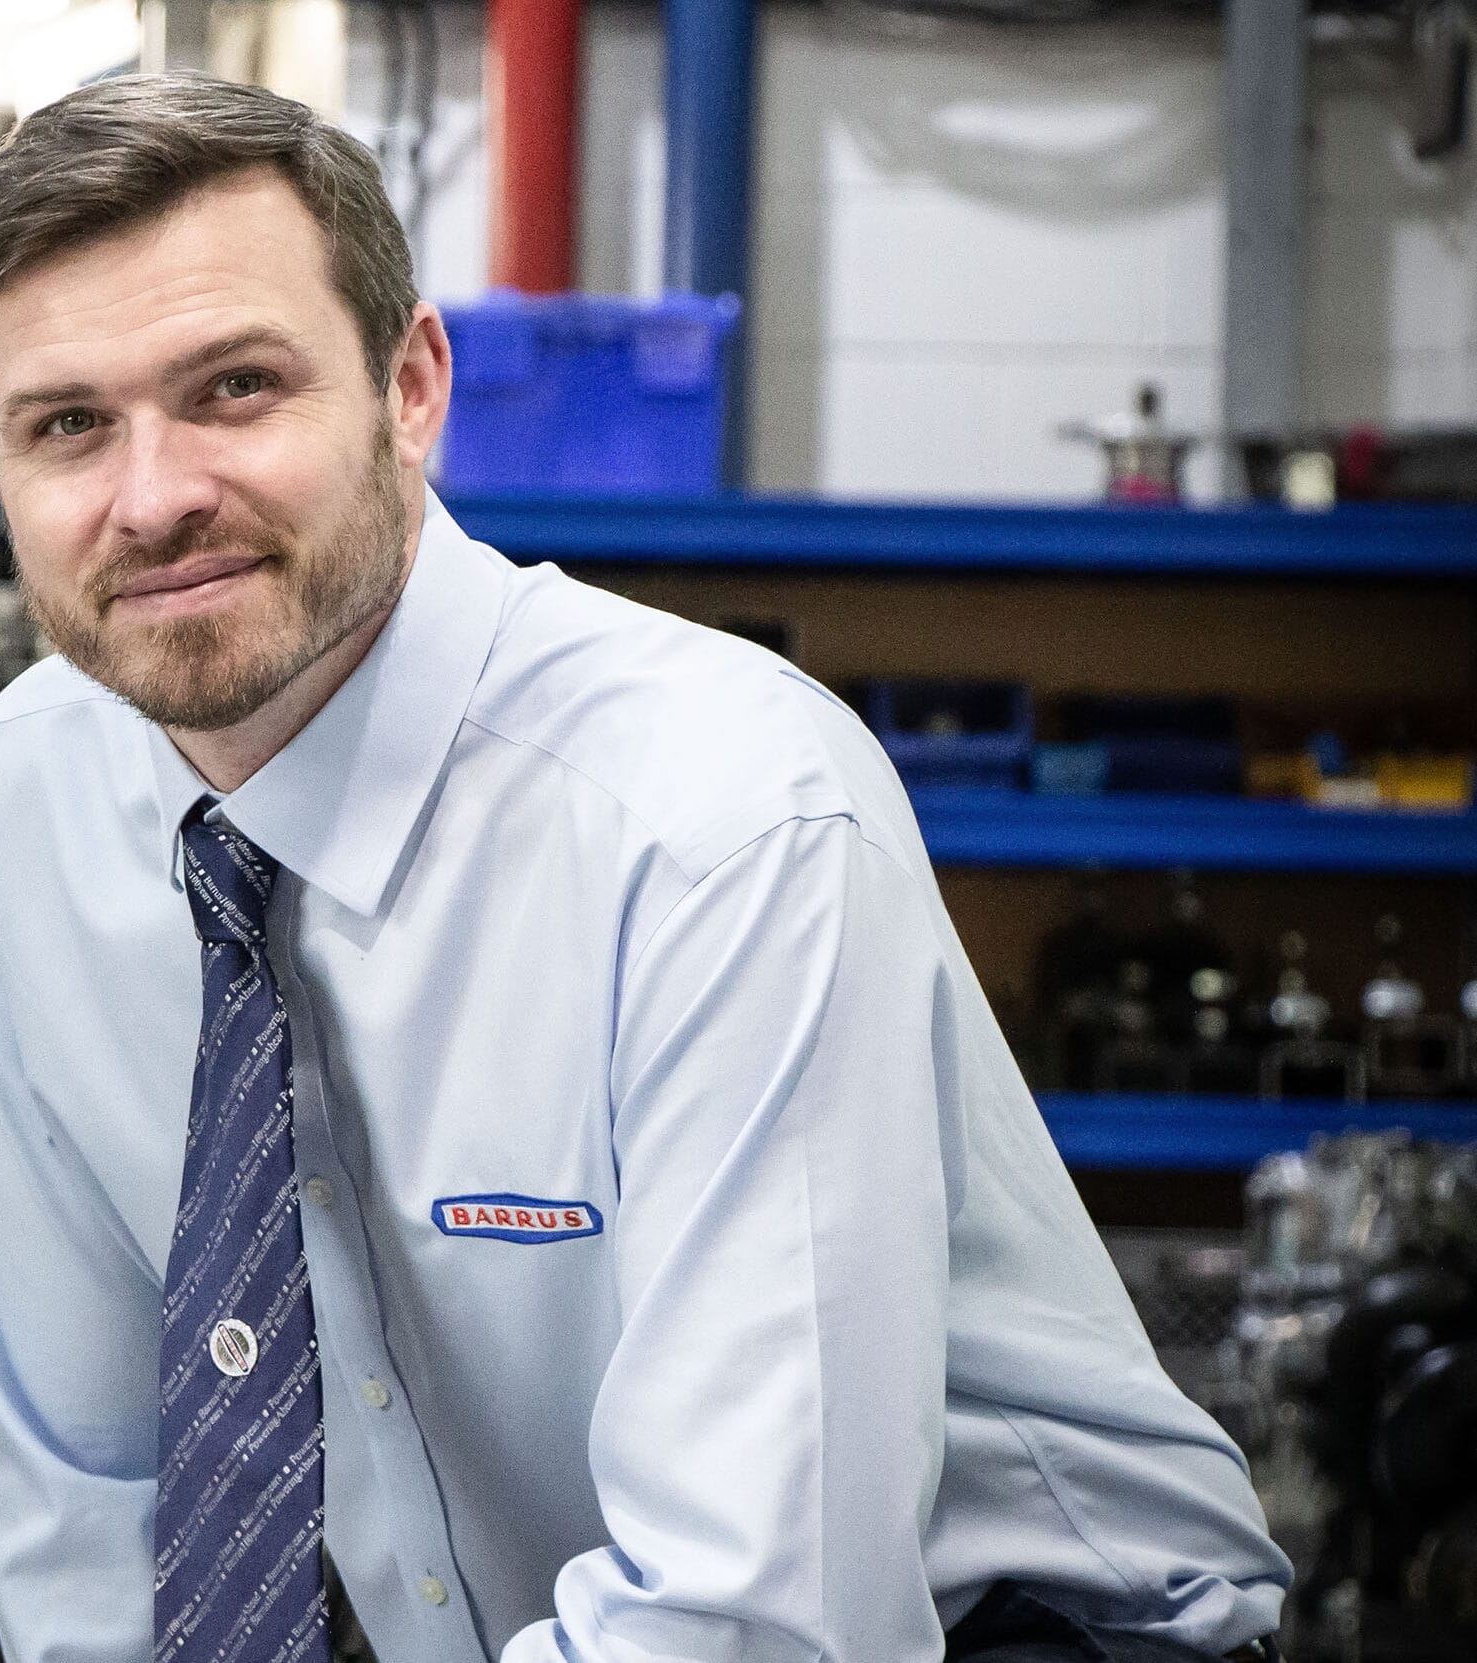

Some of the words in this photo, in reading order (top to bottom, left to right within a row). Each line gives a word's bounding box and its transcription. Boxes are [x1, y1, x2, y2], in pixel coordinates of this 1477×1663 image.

[203, 875, 254, 929] Barrus100years
[452, 1206, 583, 1229] BARRUS
[246, 1392, 299, 1454] PoweringAhead
